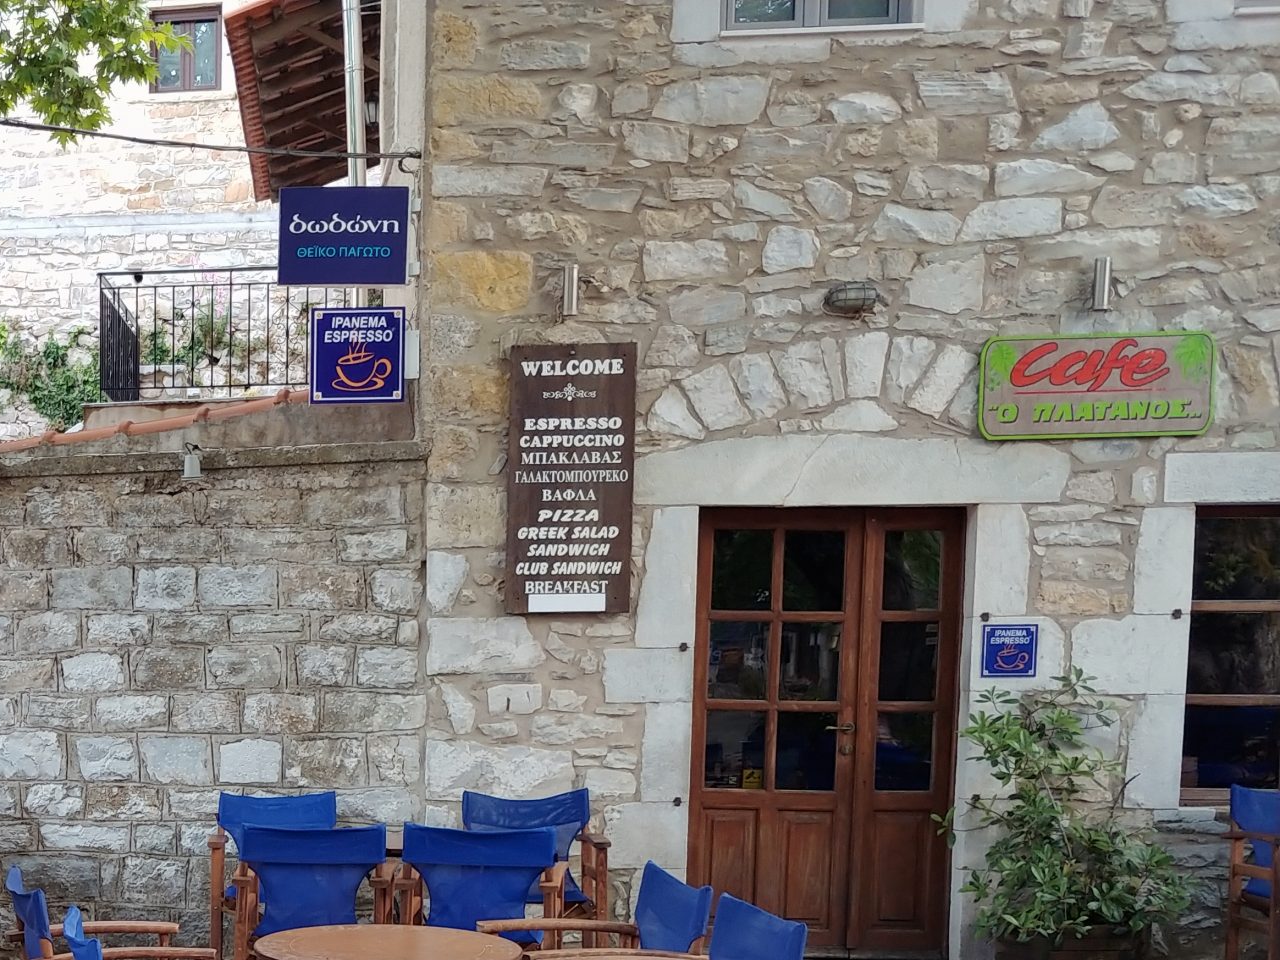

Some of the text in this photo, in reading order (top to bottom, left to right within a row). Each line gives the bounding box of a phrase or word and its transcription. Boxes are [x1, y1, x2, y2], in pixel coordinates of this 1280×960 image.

[289, 213, 400, 234] δωδώνη
[297, 246, 391, 258] ΘΕΪΚΟ ΠΑΓΩΤΟ
[332, 316, 387, 329] IPANEMA
[324, 329, 393, 343] ESPRESSO
[521, 359, 624, 376] WELCOME
[524, 417, 622, 430] ESPRESSO
[520, 434, 625, 448] CAPPUCCINO
[521, 452, 622, 465] ΜΠΑΚΛΑΒΑΣ
[515, 469, 629, 484] ΓΑΛΑΚΤΟΜΠΟΥΡΕΚΟ
[542, 489, 597, 501] ΒΑΦΛΑ
[538, 509, 599, 522] PIZZA
[518, 526, 619, 540] GREEK SALAD
[527, 544, 610, 557] SANDWICH
[516, 561, 622, 575] CLUB SANDWICH
[525, 580, 608, 594] BREAKFAST
[990, 637, 1030, 645] ESPRESSO
